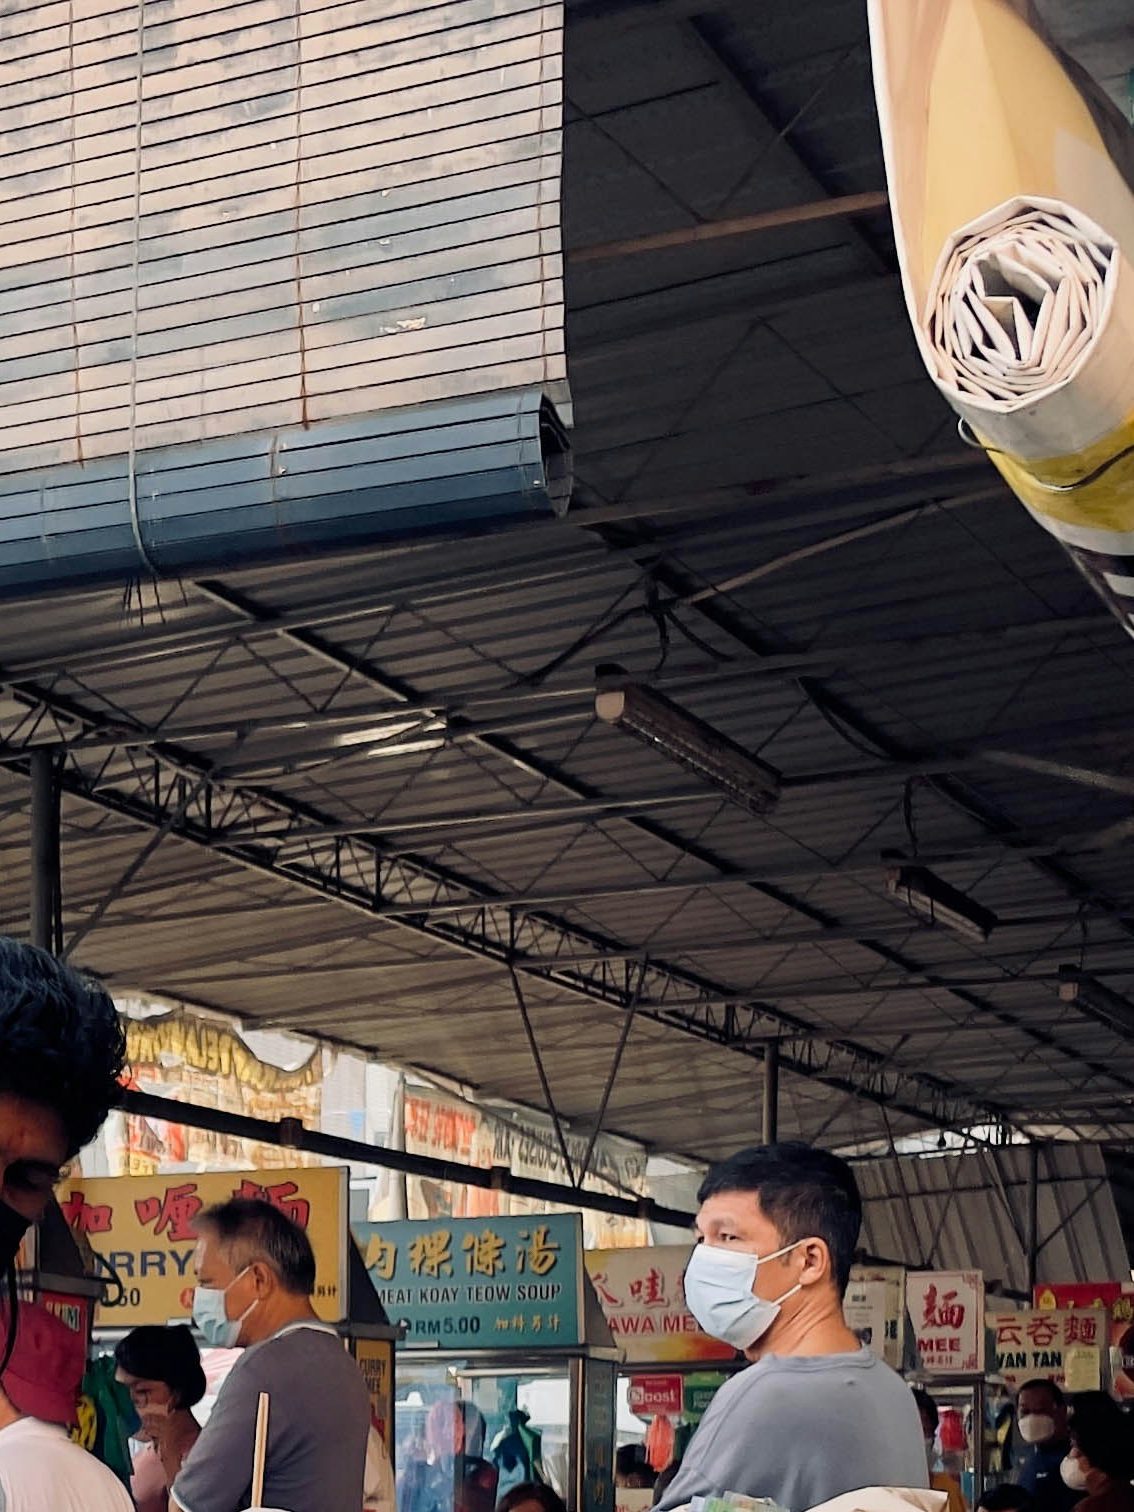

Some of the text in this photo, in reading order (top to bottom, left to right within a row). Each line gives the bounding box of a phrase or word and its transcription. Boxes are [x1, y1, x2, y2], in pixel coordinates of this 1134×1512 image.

[420, 1287, 459, 1304] KOAY
[467, 1285, 511, 1303] TEOW
[518, 1282, 561, 1301] SOUP
[608, 1311, 704, 1334] AWA ME
[917, 1337, 961, 1352] MEE
[1033, 1351, 1062, 1367] TAN
